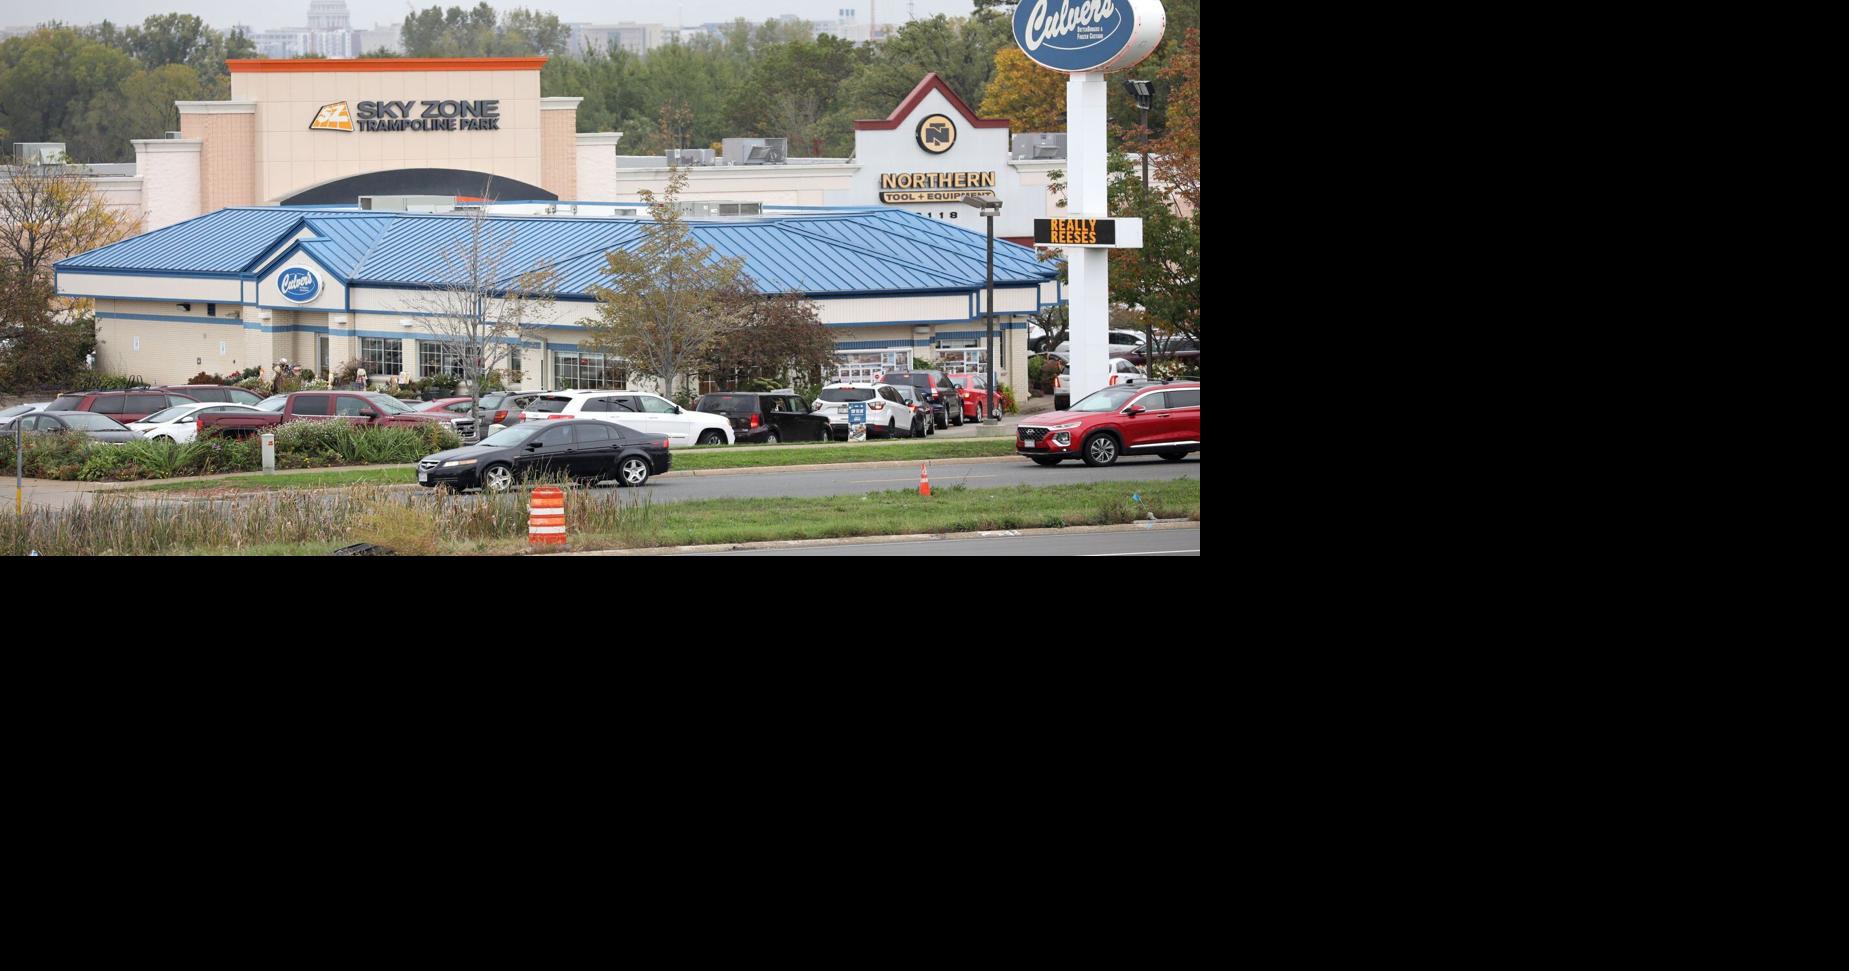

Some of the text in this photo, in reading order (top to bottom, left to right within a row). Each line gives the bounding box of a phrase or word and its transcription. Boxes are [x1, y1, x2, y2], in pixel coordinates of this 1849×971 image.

[357, 100, 500, 119] SKY ZONE
[357, 118, 500, 132] TRAMPOLINE PARK
[880, 171, 996, 189] NORTHERN
[886, 193, 915, 201] TOOL
[916, 211, 958, 219] 118
[1050, 218, 1097, 231] REALLY
[1050, 230, 1097, 244] REESES
